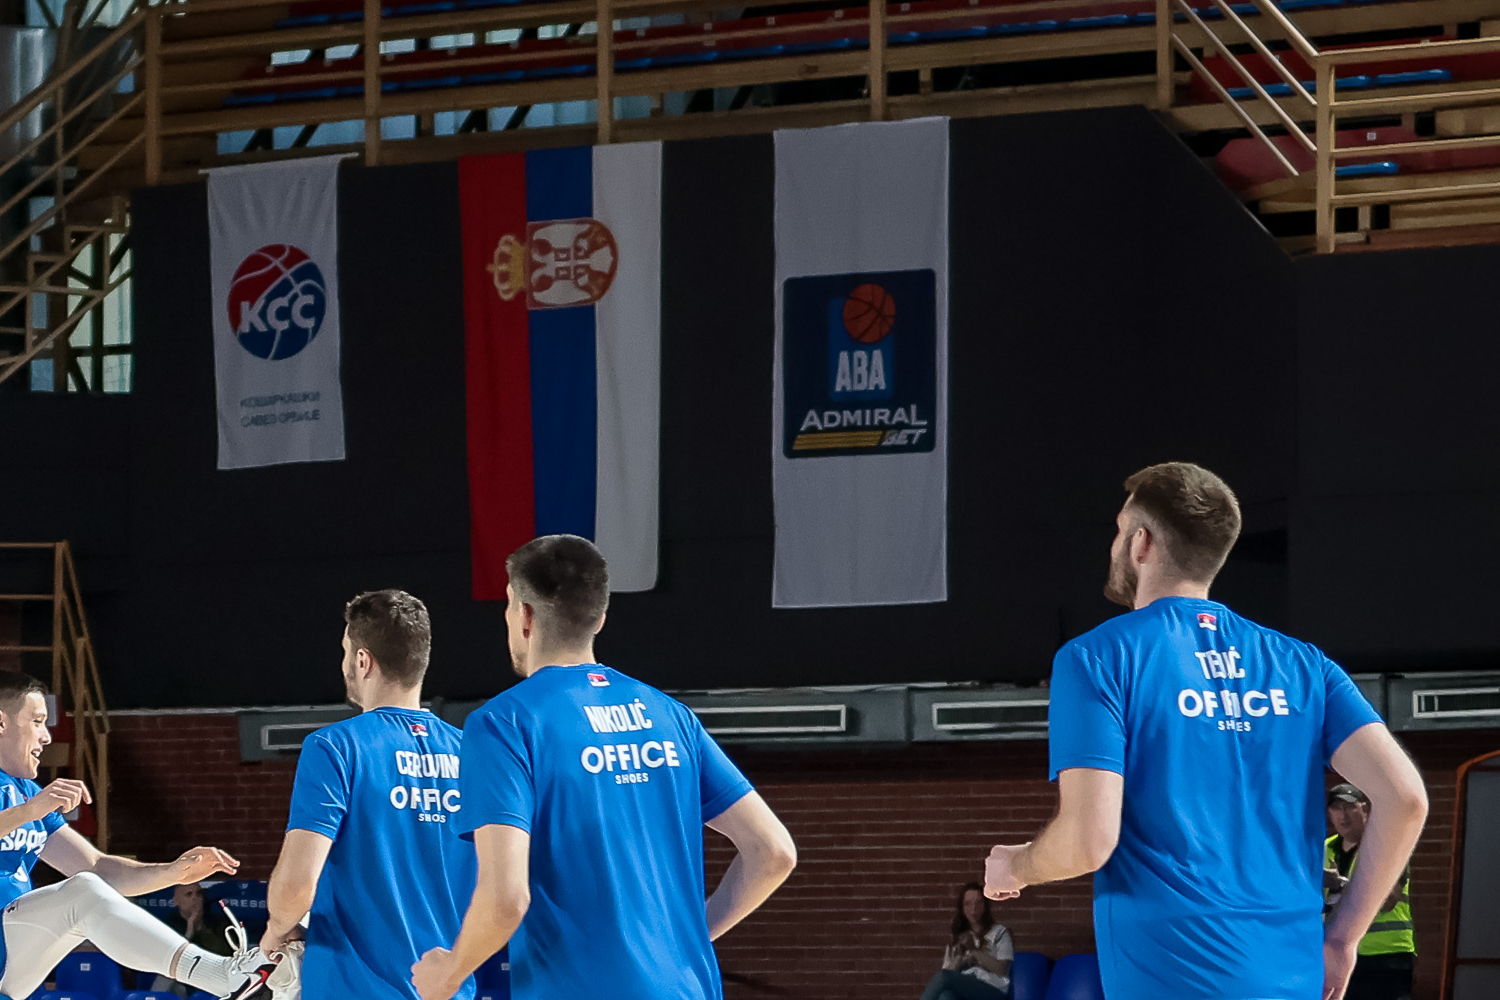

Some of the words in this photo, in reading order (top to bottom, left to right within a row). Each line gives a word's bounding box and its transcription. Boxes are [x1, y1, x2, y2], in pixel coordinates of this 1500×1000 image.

[835, 349, 887, 393] ABA
[800, 404, 928, 431] ADMIRAL
[583, 698, 653, 733] NIKOLIĆ
[1217, 720, 1252, 732] SHES
[580, 740, 680, 774] OFFICE
[614, 773, 649, 784] SHOES
[389, 785, 461, 813] OFFIC
[418, 813, 447, 823] SHOS
[137, 898, 177, 908] RESS
